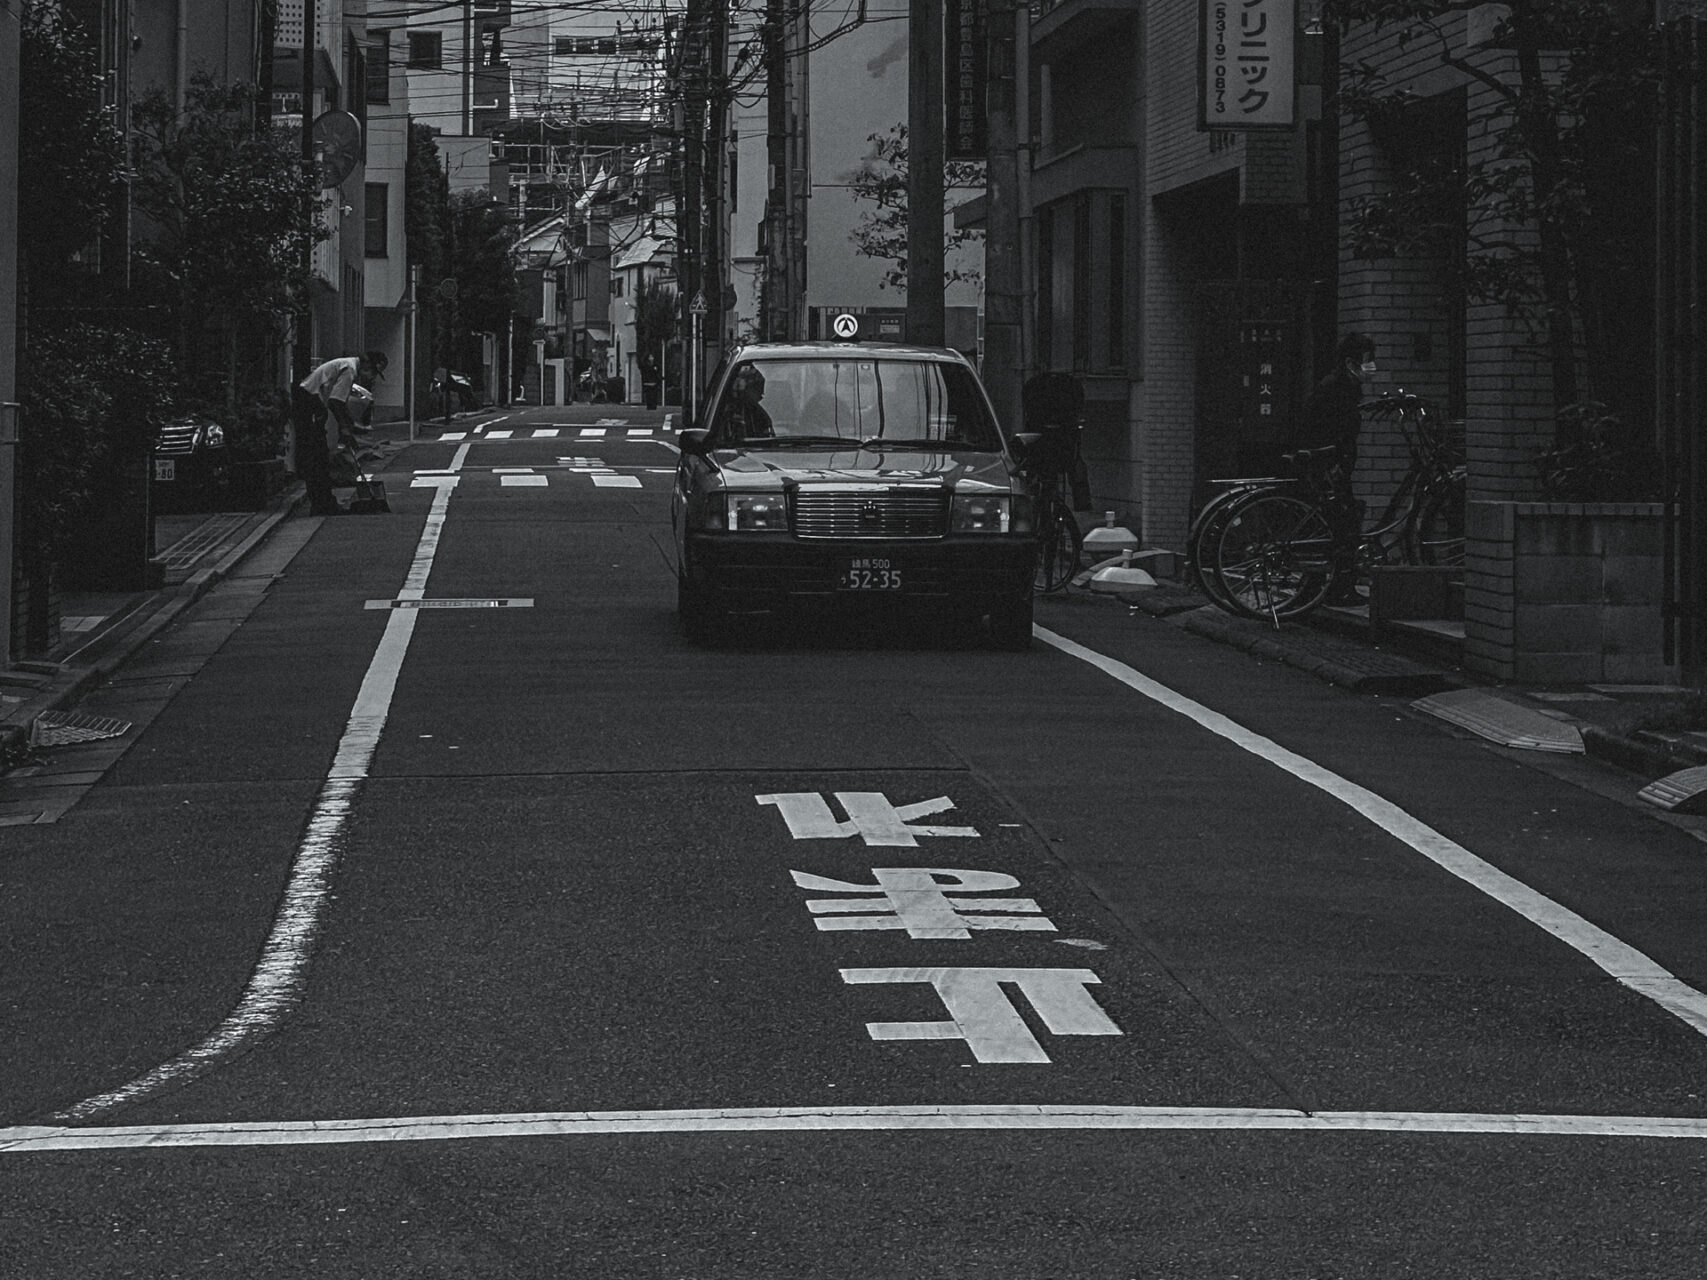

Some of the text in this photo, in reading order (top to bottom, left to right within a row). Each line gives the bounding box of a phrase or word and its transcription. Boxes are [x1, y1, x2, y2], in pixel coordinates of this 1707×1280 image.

[850, 570, 901, 589] 52-35
[755, 792, 1124, 1063] 止まれ
